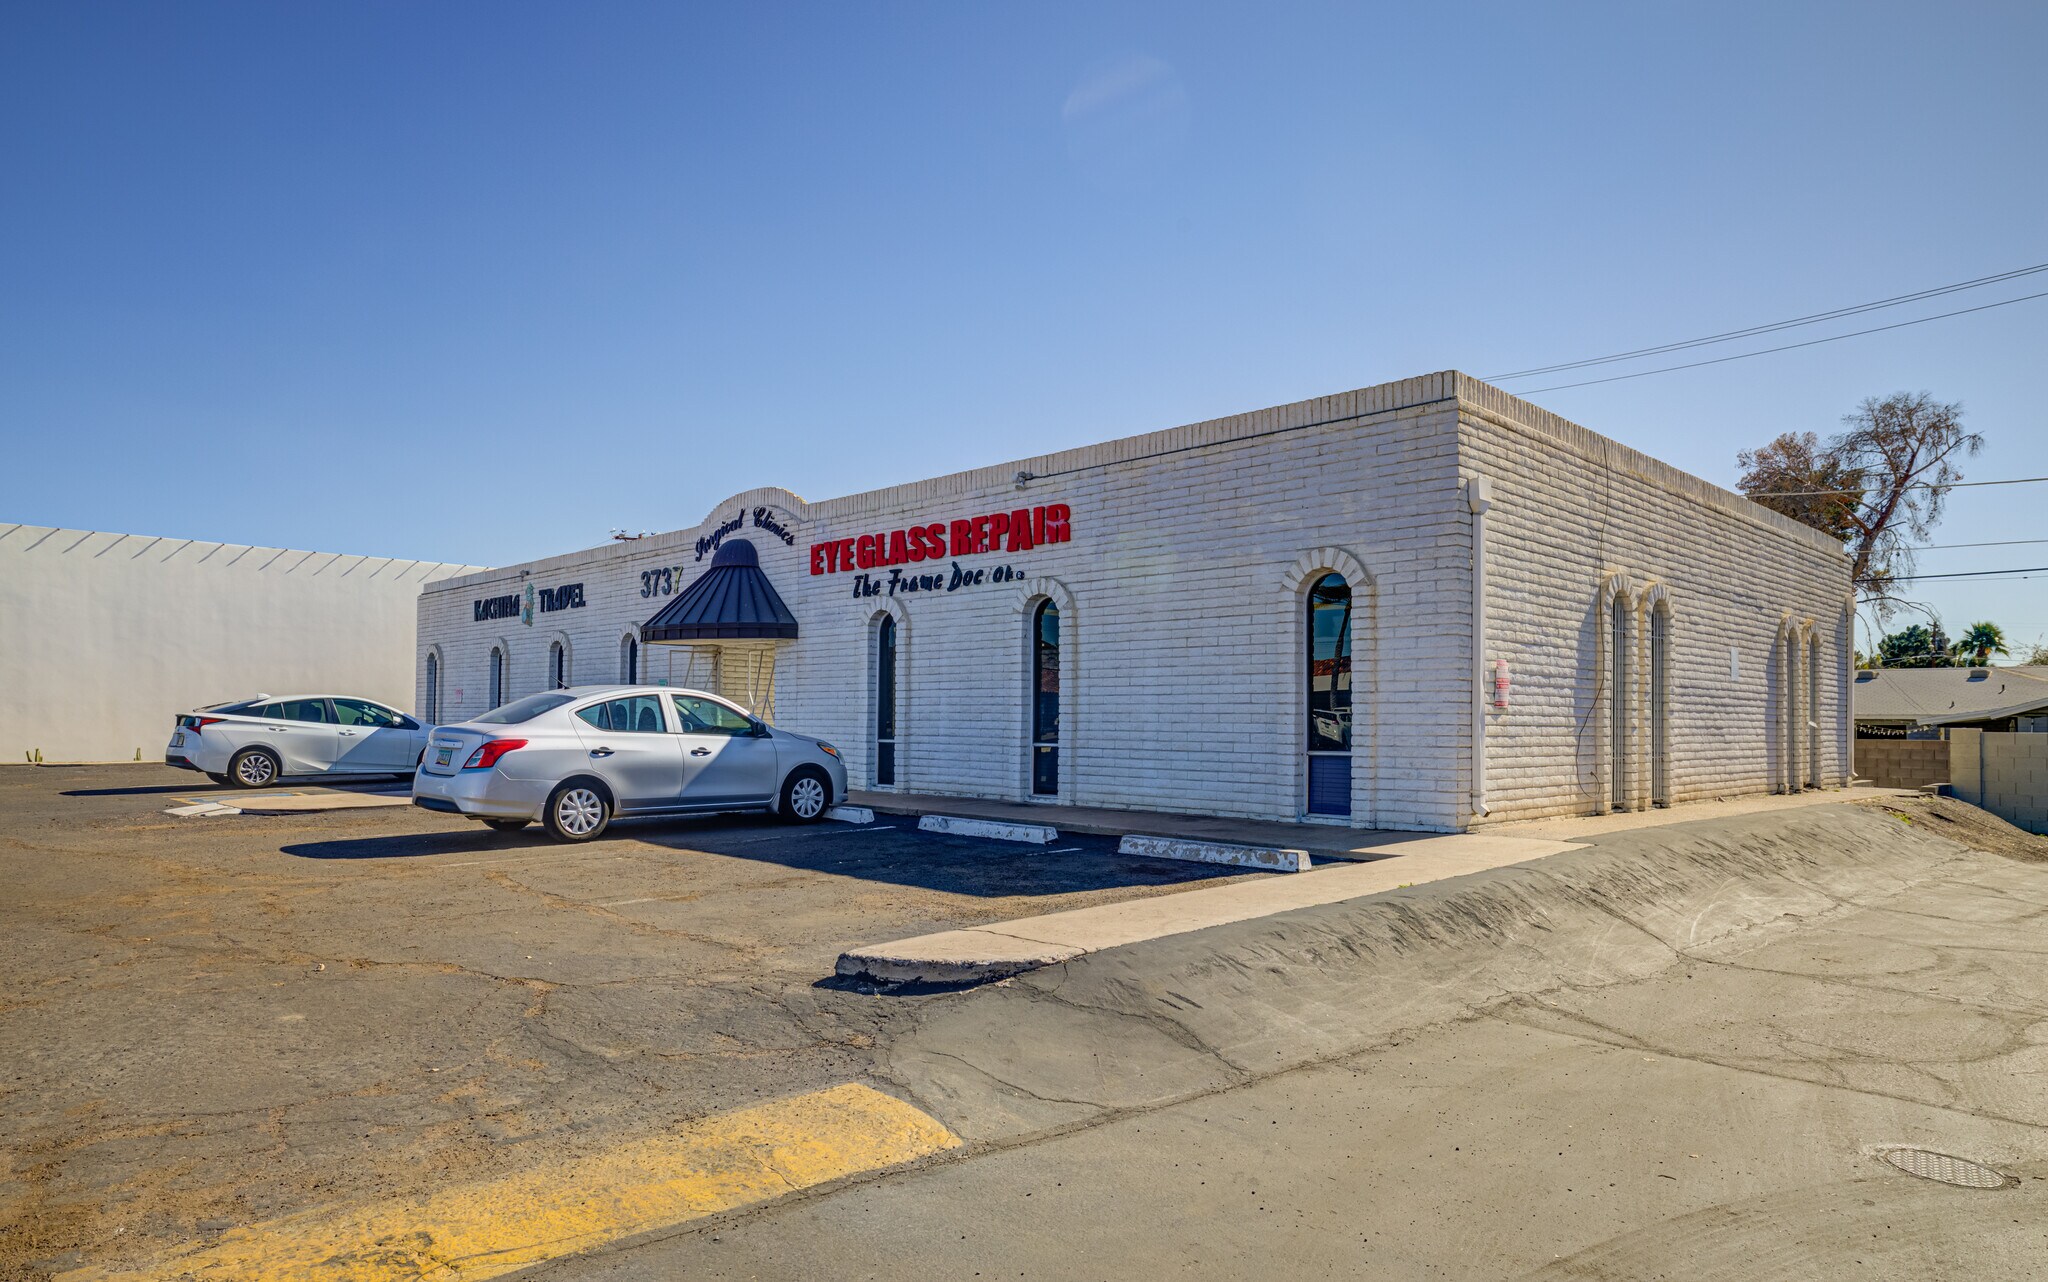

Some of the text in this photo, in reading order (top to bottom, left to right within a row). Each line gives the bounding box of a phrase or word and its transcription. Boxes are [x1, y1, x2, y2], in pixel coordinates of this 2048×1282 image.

[753, 506, 795, 546] Clinics
[810, 503, 1072, 576] EYEGLASS REPAIR
[539, 583, 586, 612] TRAVEL
[640, 565, 684, 598] 3737
[853, 573, 881, 598] The
[888, 568, 944, 597] Frame
